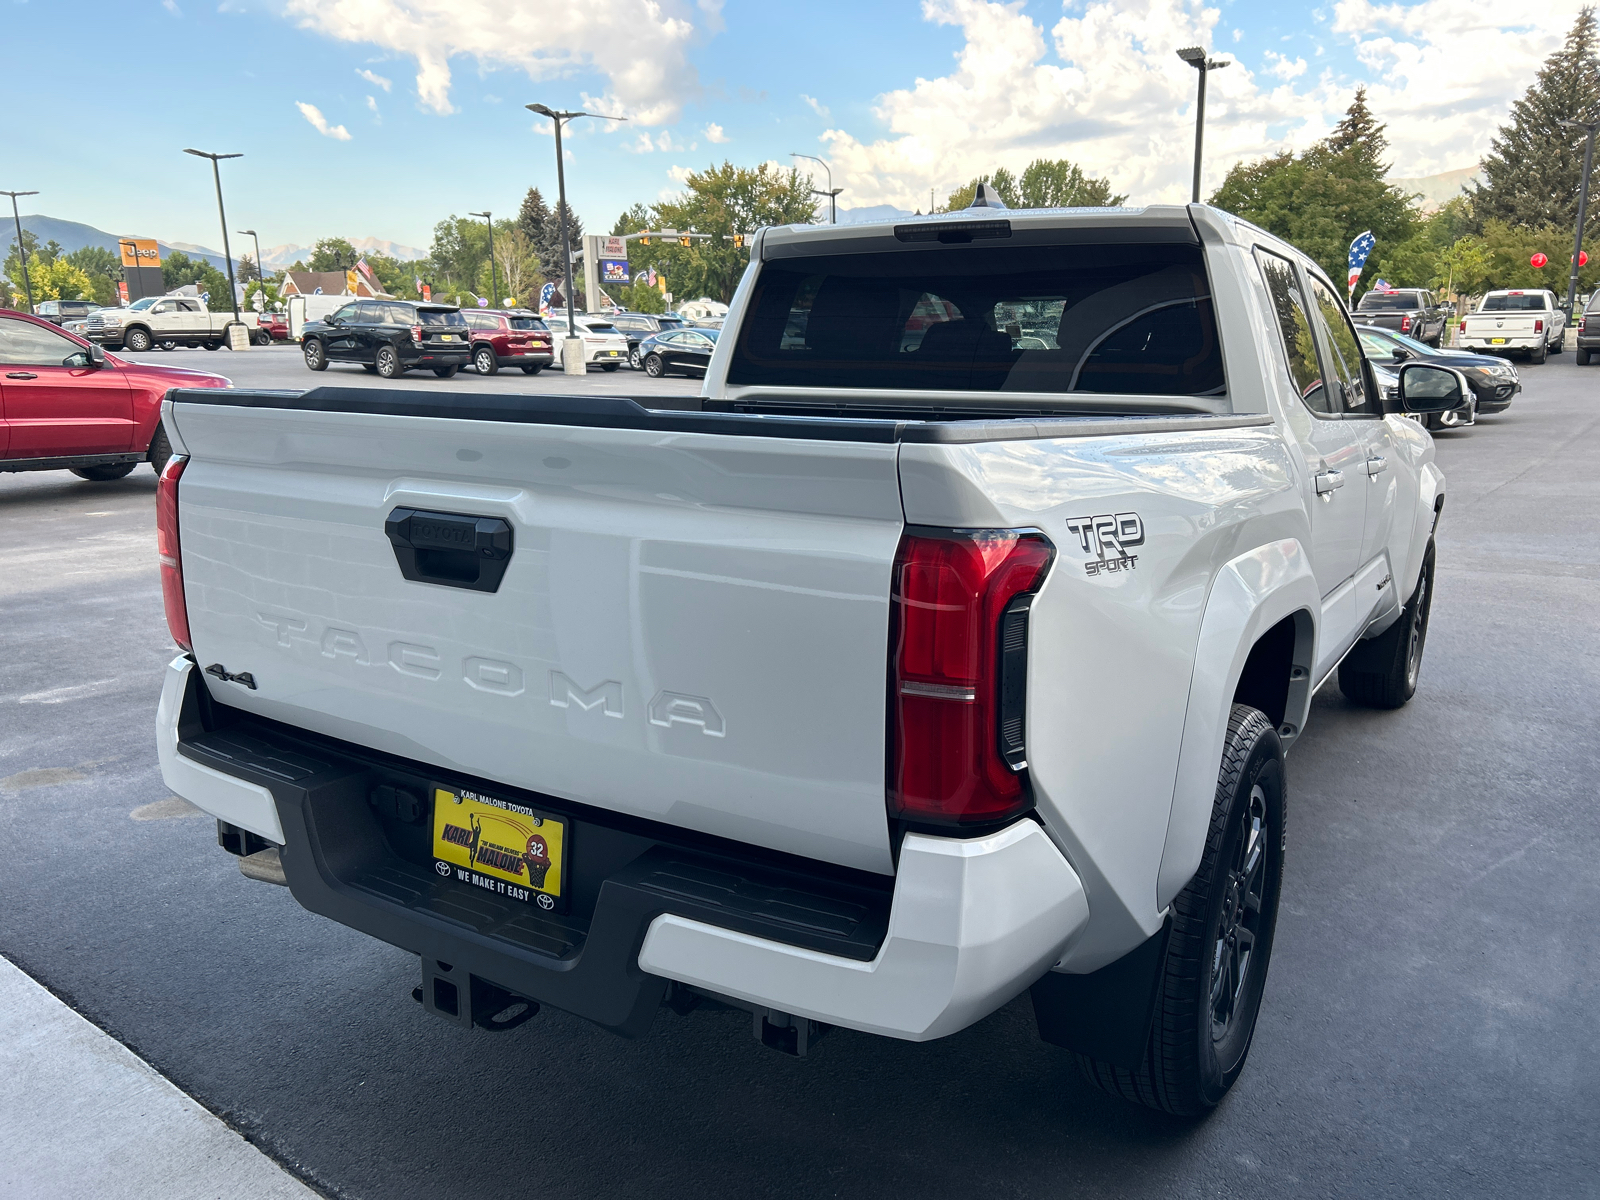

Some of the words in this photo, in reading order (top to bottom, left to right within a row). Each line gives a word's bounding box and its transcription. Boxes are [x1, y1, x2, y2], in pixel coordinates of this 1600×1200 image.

[127, 245, 158, 259] Jeep
[413, 523, 472, 543] TOYOTA
[1066, 512, 1145, 560] TRD
[1085, 555, 1138, 577] SPORT
[257, 611, 726, 738] TACOMA
[460, 790, 478, 802] KARL
[480, 795, 507, 810] MALONE
[507, 802, 534, 817] TOYOTA
[441, 823, 473, 848] KARL
[476, 845, 525, 877] MALONE
[530, 841, 544, 858] 32
[457, 869, 470, 882] WE
[472, 874, 495, 891] MAKE
[497, 883, 506, 894] IT
[507, 886, 530, 901] EASY
